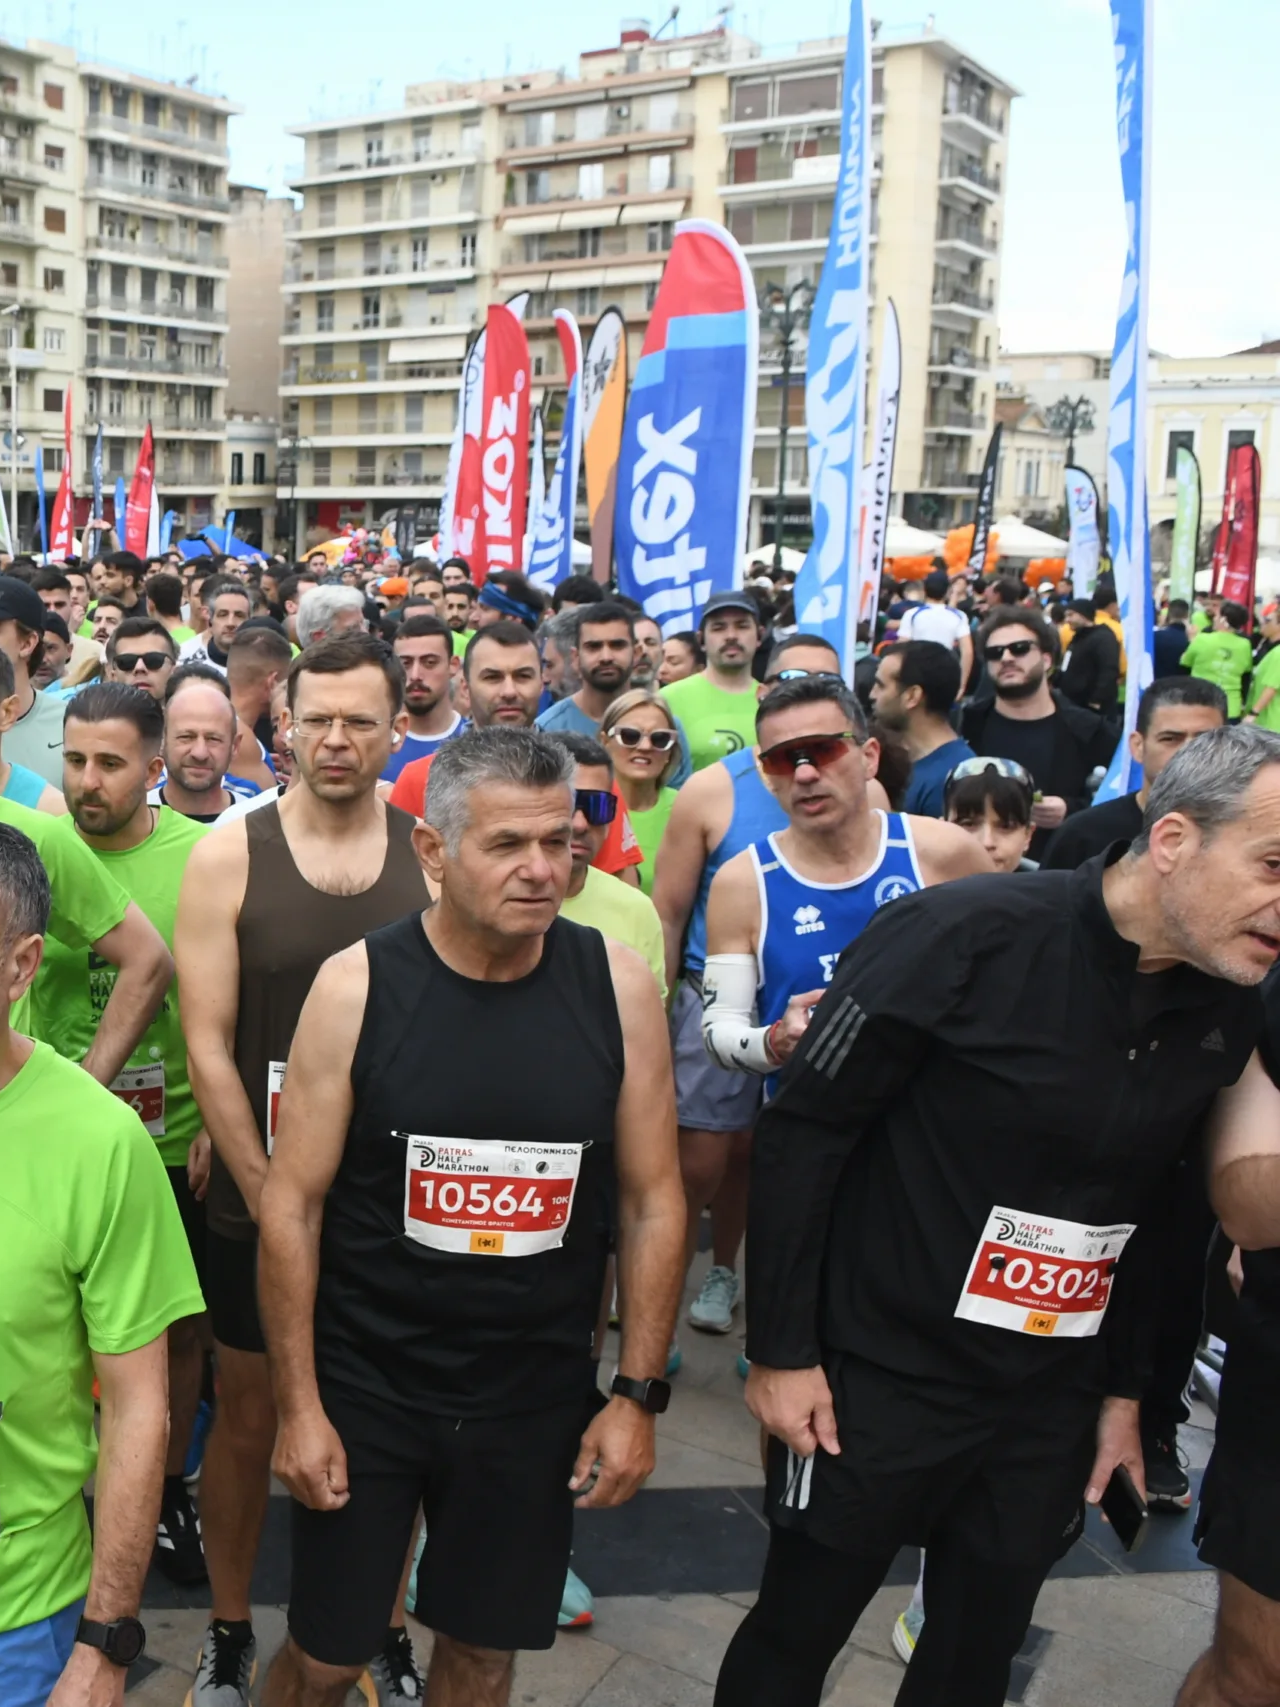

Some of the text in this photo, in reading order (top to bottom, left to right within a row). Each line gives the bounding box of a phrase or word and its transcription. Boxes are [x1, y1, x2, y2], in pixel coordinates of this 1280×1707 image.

[438, 1147, 473, 1156] PATRAS
[437, 1155, 462, 1163] HALF
[437, 1163, 489, 1172] MARATHON
[420, 1180, 569, 1217] 10564 10K
[1019, 1222, 1054, 1236] PATRAS
[1016, 1231, 1041, 1240] HALF
[1013, 1238, 1065, 1255] MARATHON
[987, 1253, 1099, 1299] 10302
